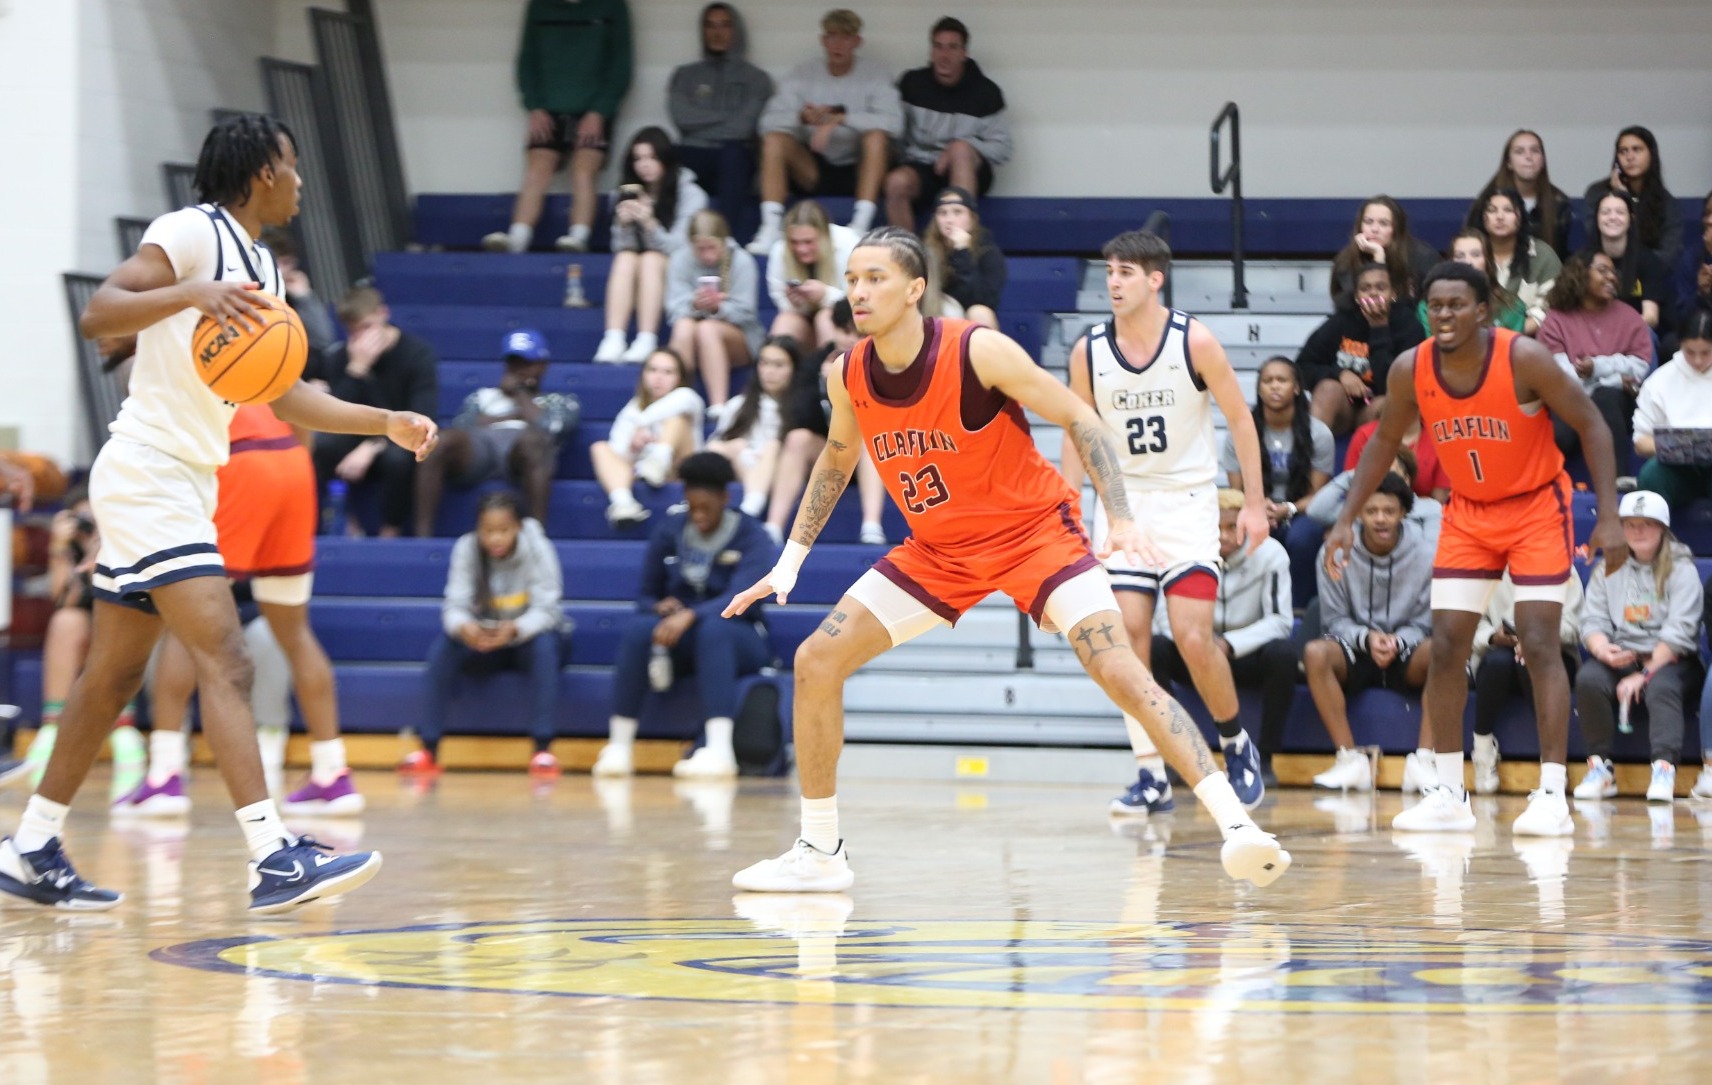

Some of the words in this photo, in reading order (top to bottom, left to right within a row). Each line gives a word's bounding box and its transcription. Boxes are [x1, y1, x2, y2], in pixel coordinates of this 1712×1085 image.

[1112, 389, 1175, 410] COKER
[873, 428, 959, 462] CLAFLIN
[1126, 415, 1168, 455] 23
[1432, 415, 1511, 444] CLAFLIN
[1468, 450, 1484, 483] 1
[899, 463, 950, 514] 23
